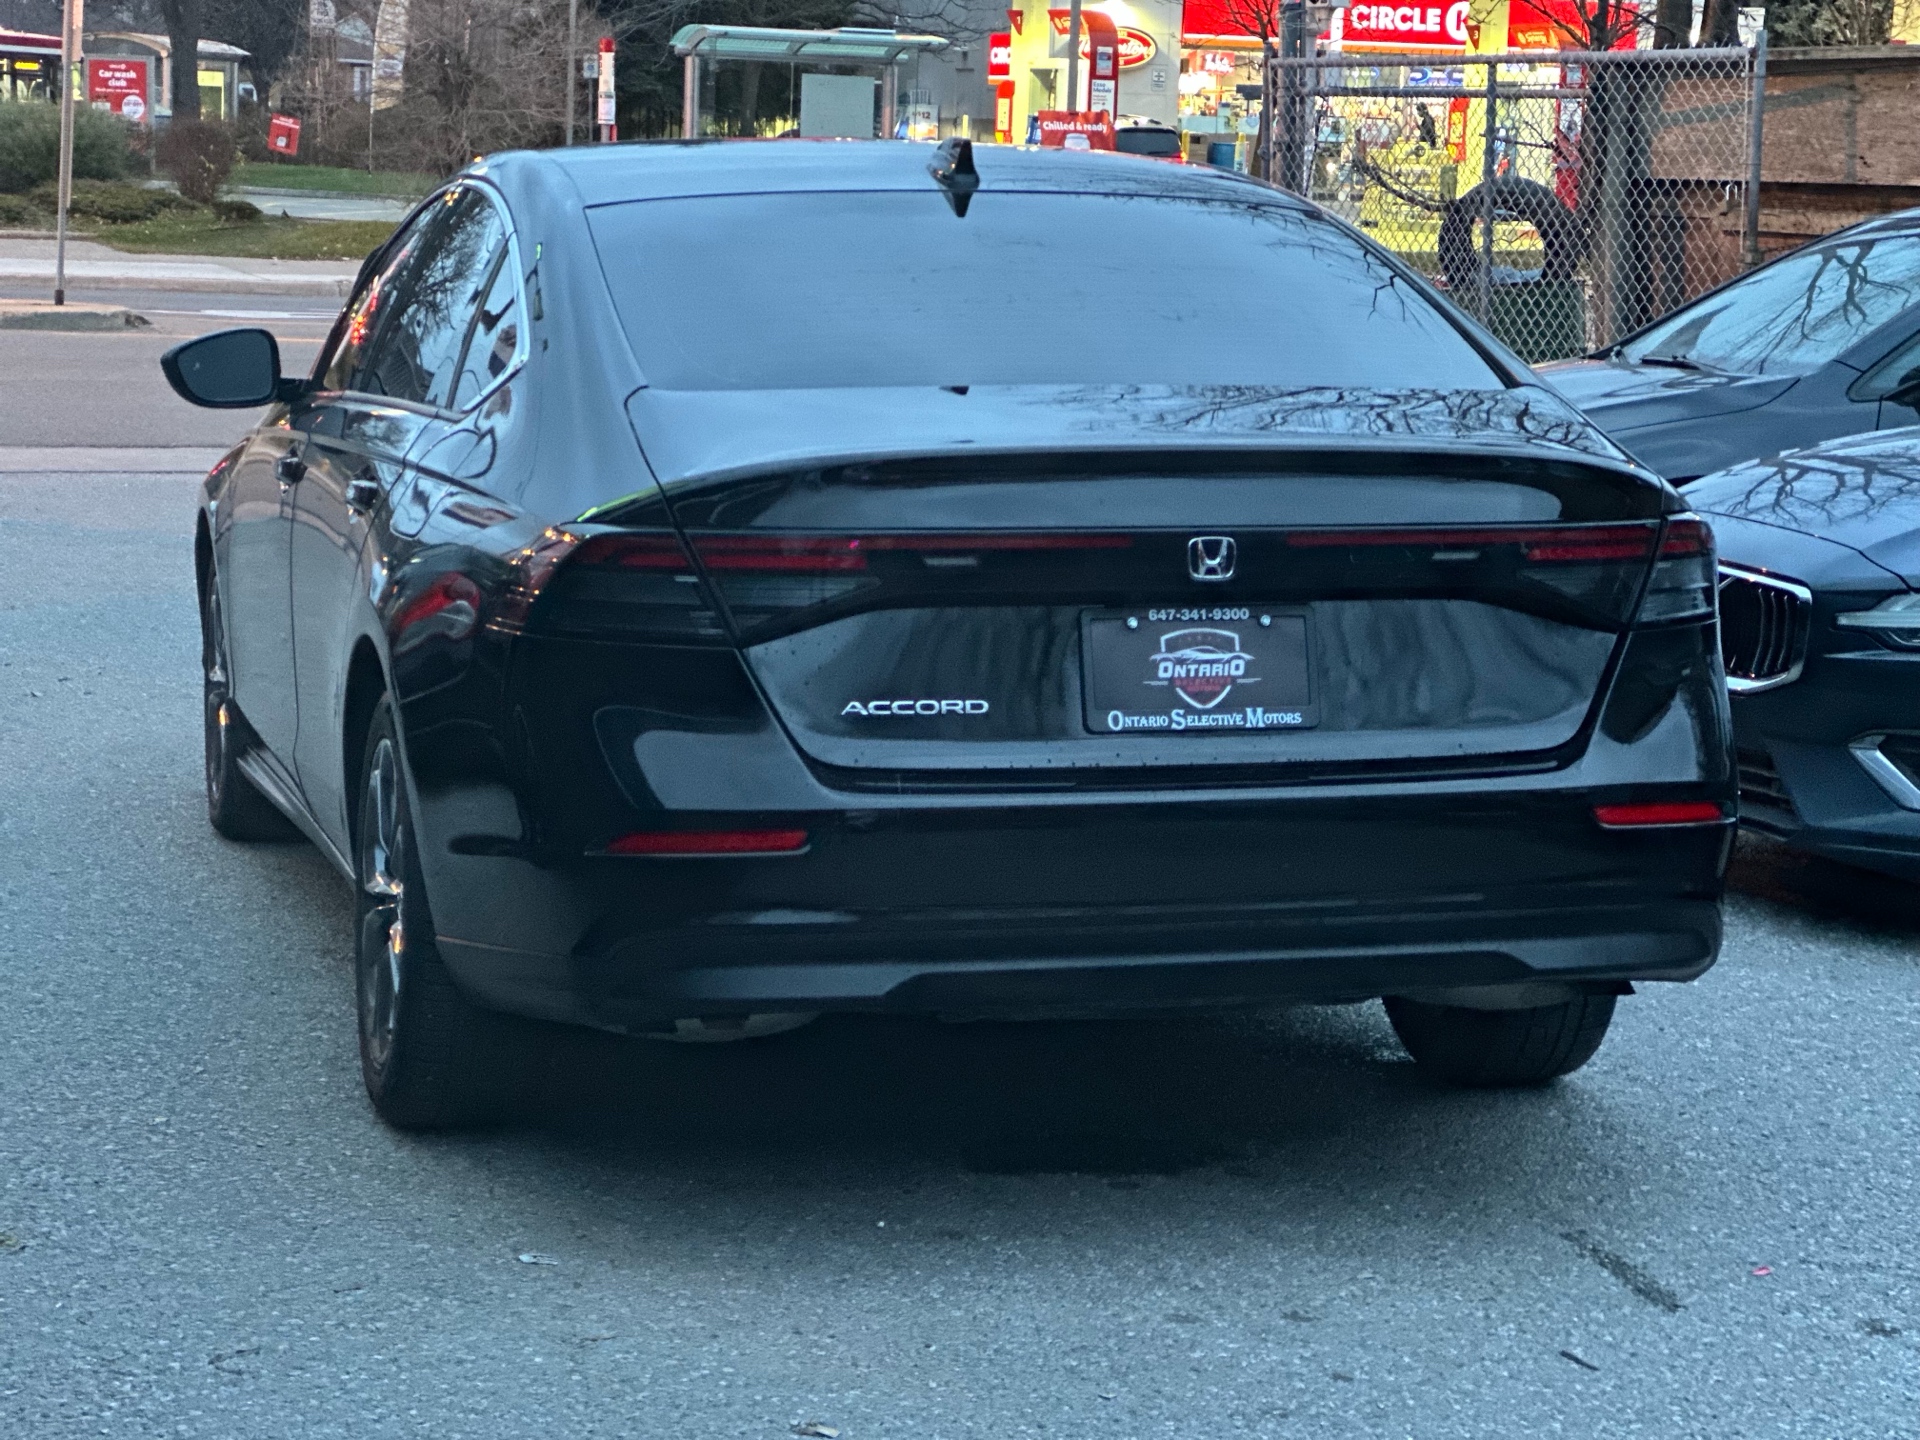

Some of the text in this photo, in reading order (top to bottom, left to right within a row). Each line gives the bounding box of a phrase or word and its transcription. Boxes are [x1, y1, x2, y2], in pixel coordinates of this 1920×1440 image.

[1352, 5, 1441, 31] CIRCLE
[1473, 30, 1479, 39] 3
[98, 69, 137, 79] Car wash
[108, 78, 127, 87] club
[1042, 121, 1108, 134] Chilled & ready
[1148, 607, 1250, 621] 647-341-9300
[1158, 659, 1246, 679] ONTARIO
[841, 699, 990, 716] ACCORD
